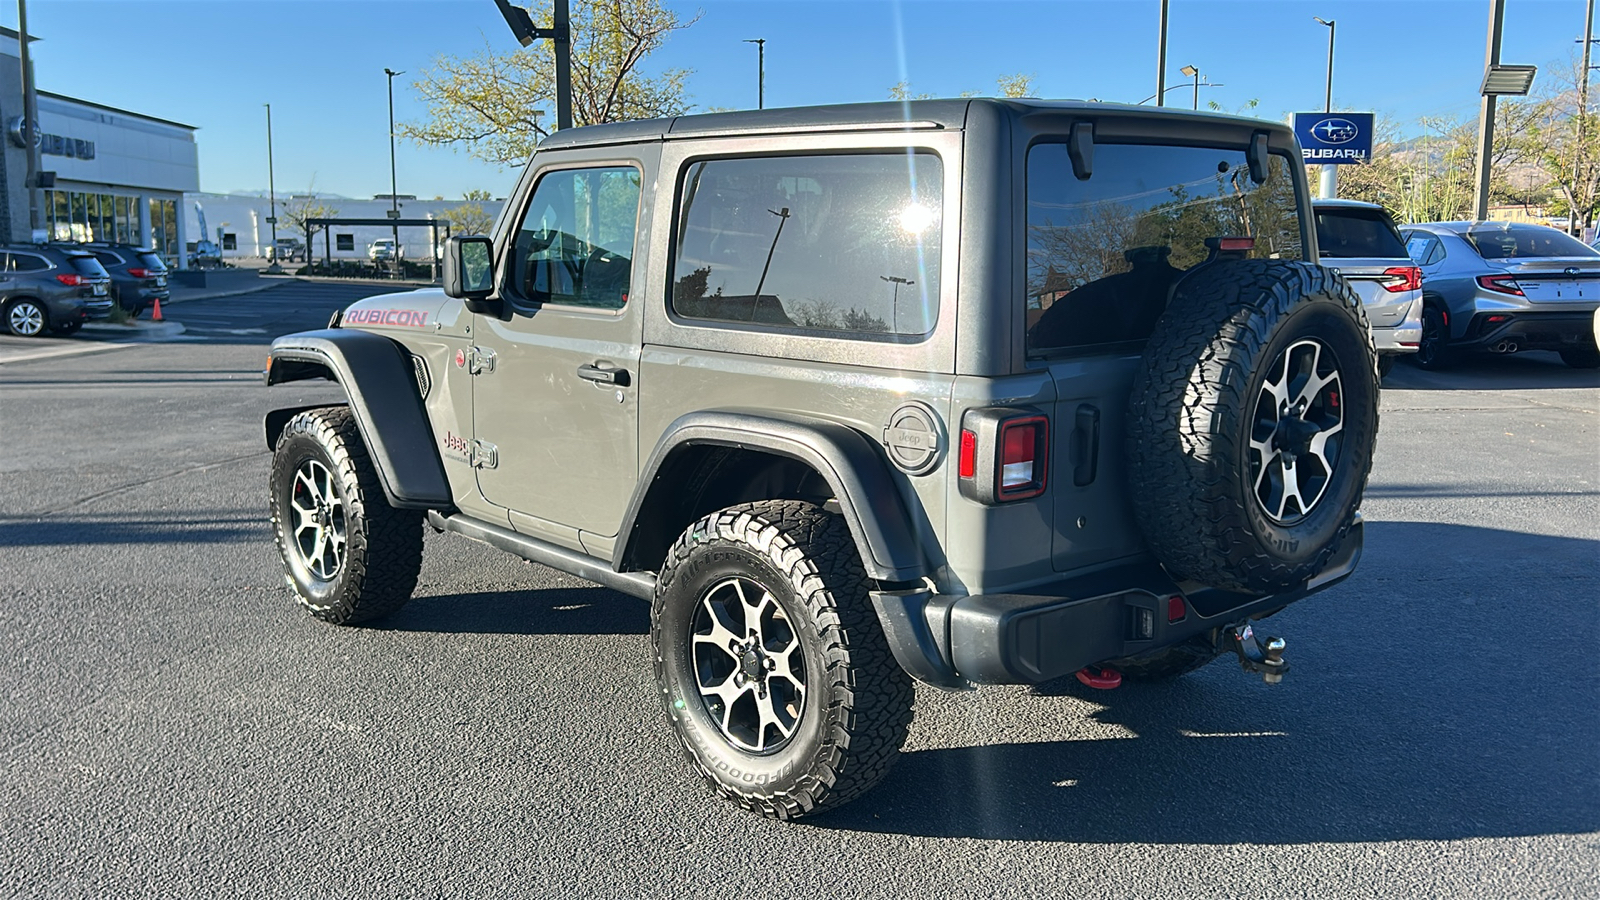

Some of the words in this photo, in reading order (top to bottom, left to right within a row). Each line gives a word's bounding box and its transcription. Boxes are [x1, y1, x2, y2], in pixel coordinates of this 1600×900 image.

[41, 133, 95, 160] UBARU
[1302, 148, 1365, 159] SUBARU
[345, 310, 428, 327] RUBICON
[443, 430, 468, 456] Jeep
[898, 432, 920, 446] Jeep
[683, 715, 794, 787] BFGoodrich
